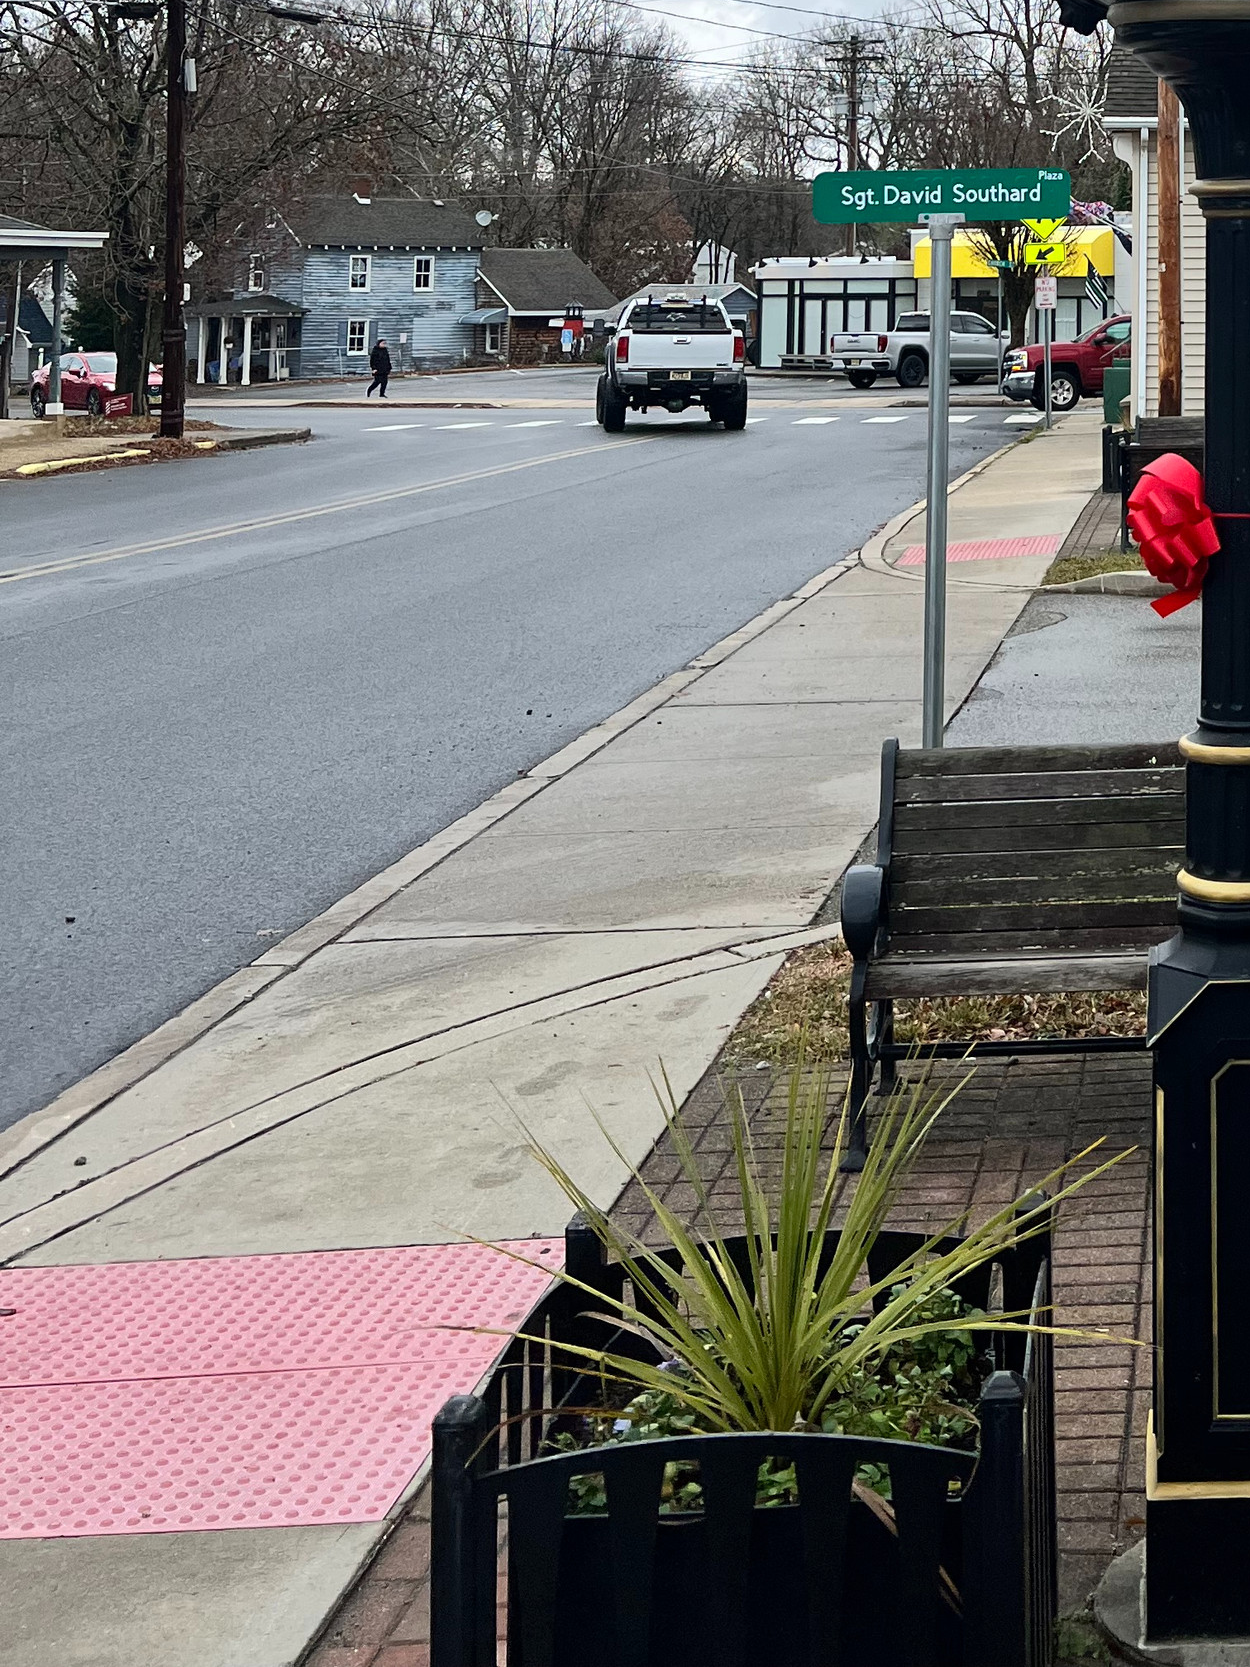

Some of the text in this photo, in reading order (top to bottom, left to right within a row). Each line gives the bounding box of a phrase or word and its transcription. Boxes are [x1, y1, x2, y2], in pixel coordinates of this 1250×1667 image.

[1038, 170, 1063, 181] Plaza
[841, 182, 1041, 211] Sgt. David Southard
